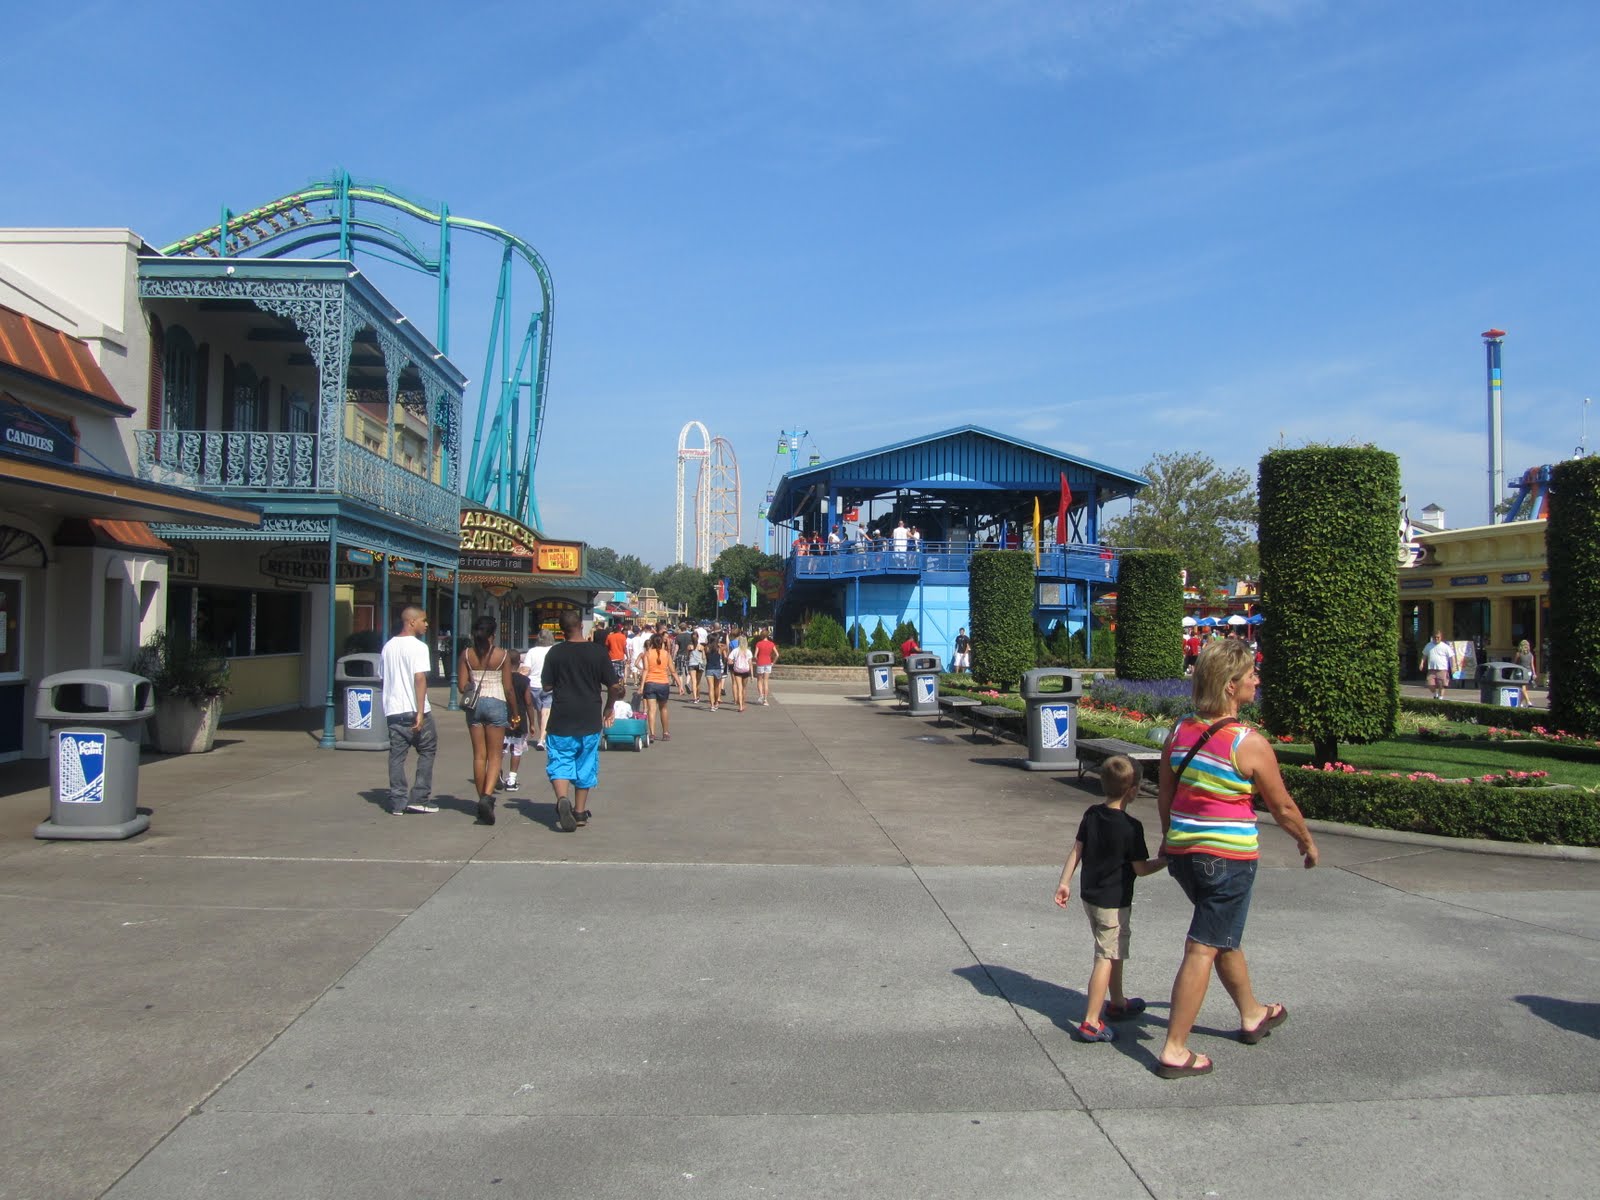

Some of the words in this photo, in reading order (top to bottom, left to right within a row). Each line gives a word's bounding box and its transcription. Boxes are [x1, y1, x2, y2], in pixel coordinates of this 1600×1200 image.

[6, 429, 54, 452] CANDIES
[462, 511, 536, 549] ALDRICH
[459, 529, 516, 552] EATRE
[467, 557, 501, 568] Frontier
[505, 558, 522, 569] Trail
[78, 740, 104, 749] Cedar
[79, 747, 103, 755] Point
